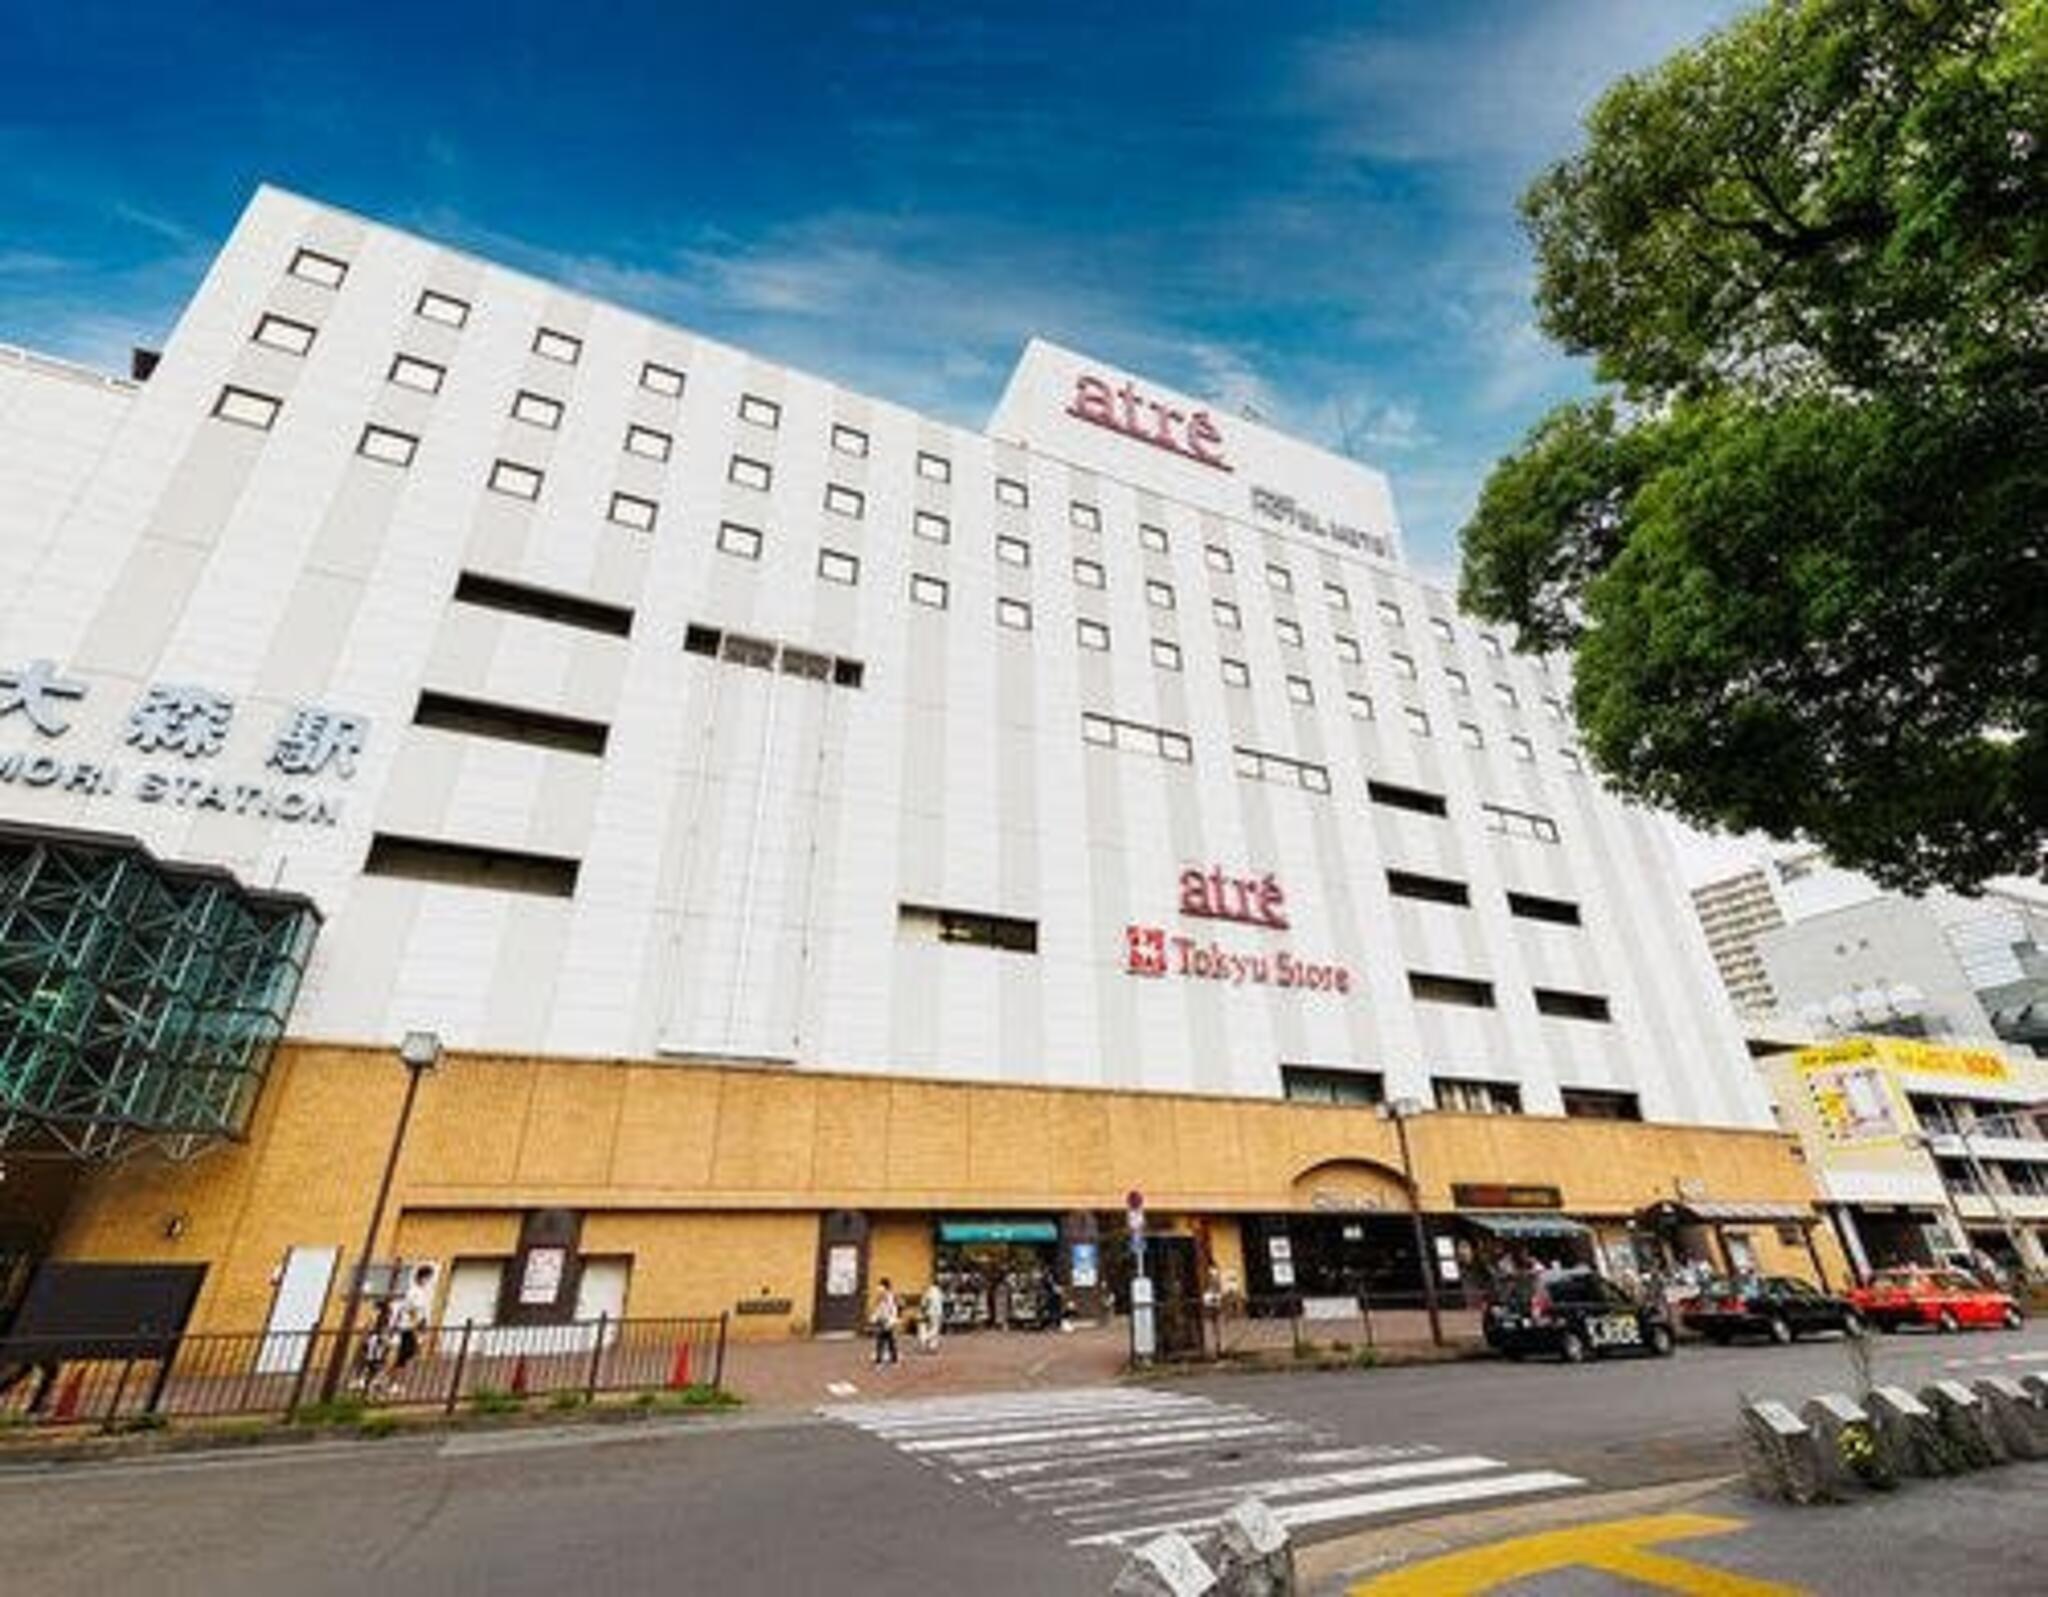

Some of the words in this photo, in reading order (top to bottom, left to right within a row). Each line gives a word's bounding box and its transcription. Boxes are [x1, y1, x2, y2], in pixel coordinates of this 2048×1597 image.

[138, 771, 346, 828] STATION
[1171, 936, 1269, 986] Tokyu
[1276, 951, 1351, 995] Store
